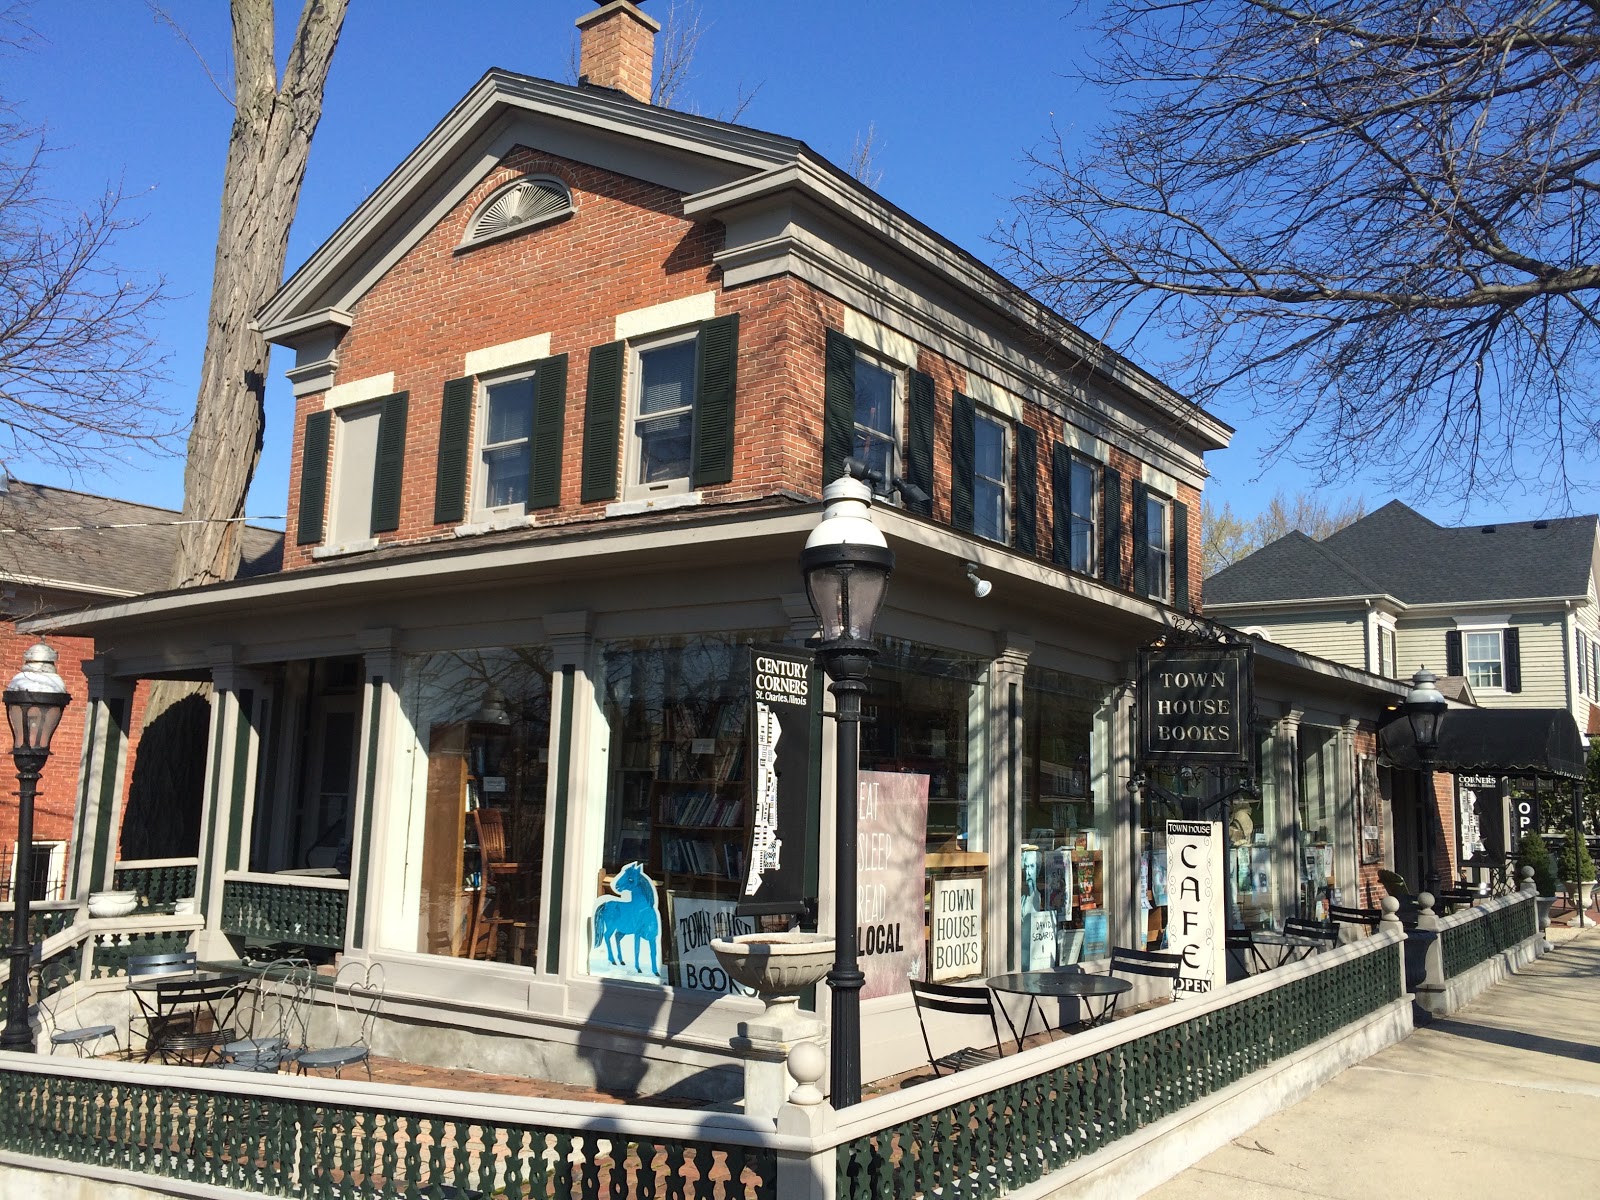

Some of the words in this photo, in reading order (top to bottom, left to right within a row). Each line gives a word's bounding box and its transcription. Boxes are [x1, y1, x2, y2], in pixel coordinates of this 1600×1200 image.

[756, 656, 808, 679] CENTURY
[756, 673, 808, 696] CORNERS
[1160, 672, 1226, 689] TOWN
[756, 690, 764, 700] St.
[765, 691, 788, 703] Charles,
[788, 694, 807, 706] Illinois
[1157, 699, 1230, 715] HOUSE
[1157, 726, 1230, 742] BOOKS
[1458, 776, 1496, 784] CORNERS
[860, 782, 880, 820] EAT
[1168, 824, 1188, 833] TOWN
[858, 833, 891, 872] SLEEP
[858, 884, 886, 924] READ
[941, 889, 974, 912] TOWN
[1180, 844, 1200, 969] CAFE
[680, 908, 711, 954] TOWN
[858, 922, 904, 957] LOCAL
[937, 915, 978, 941] HOUSE
[936, 942, 978, 970] BOOKS
[1174, 978, 1212, 992] OPEN
